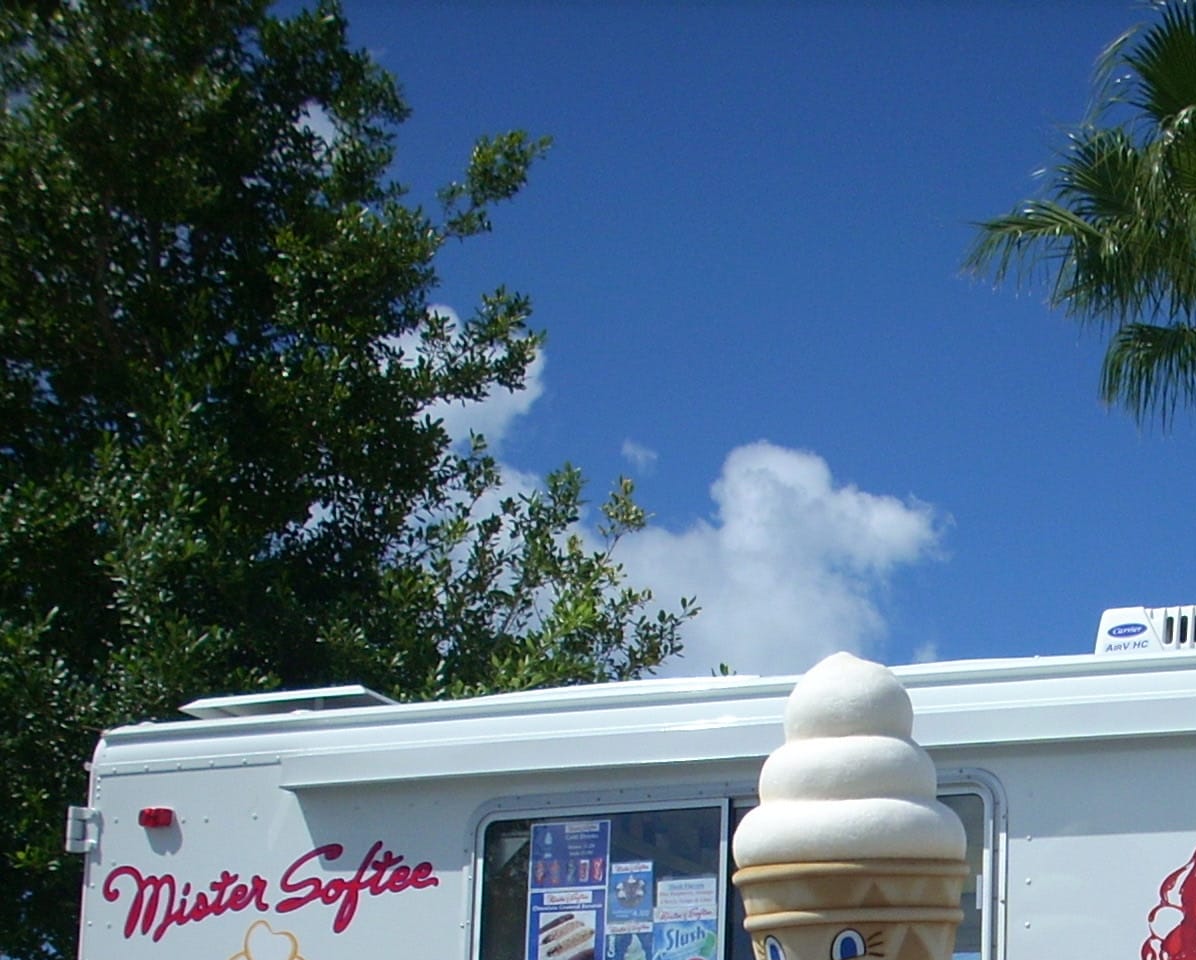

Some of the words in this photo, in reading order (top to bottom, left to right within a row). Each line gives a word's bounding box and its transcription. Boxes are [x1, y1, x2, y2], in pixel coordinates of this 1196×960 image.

[1113, 626, 1142, 635] Carrier
[1132, 640, 1149, 649] HC
[103, 865, 269, 942] Mister
[275, 840, 440, 934] Softee
[666, 926, 706, 951] Slush
